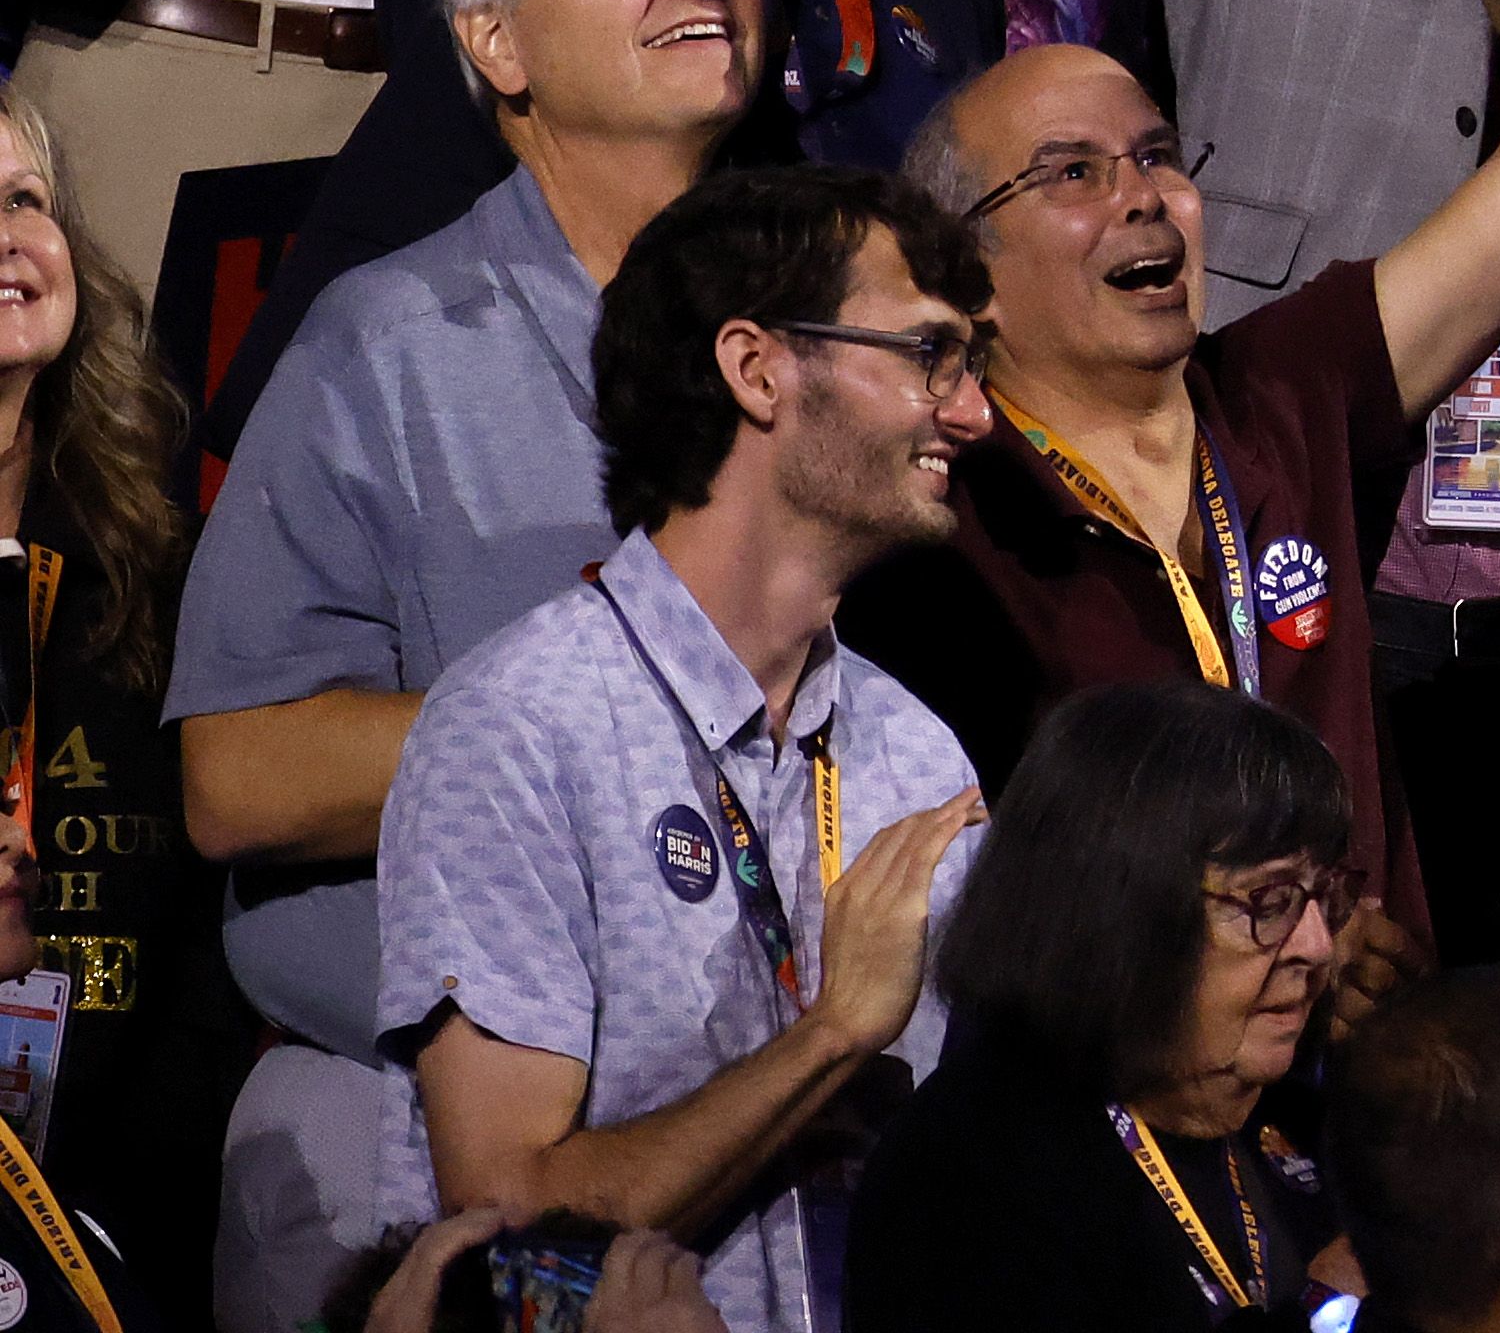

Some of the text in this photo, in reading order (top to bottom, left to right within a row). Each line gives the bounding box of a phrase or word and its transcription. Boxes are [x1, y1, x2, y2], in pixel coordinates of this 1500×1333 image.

[1208, 494, 1245, 601] DELEGATE
[1260, 539, 1328, 601] FREEDOM
[1283, 569, 1306, 591] FROM
[668, 853, 712, 876] HARRIS
[29, 1191, 82, 1272] ARIZONA
